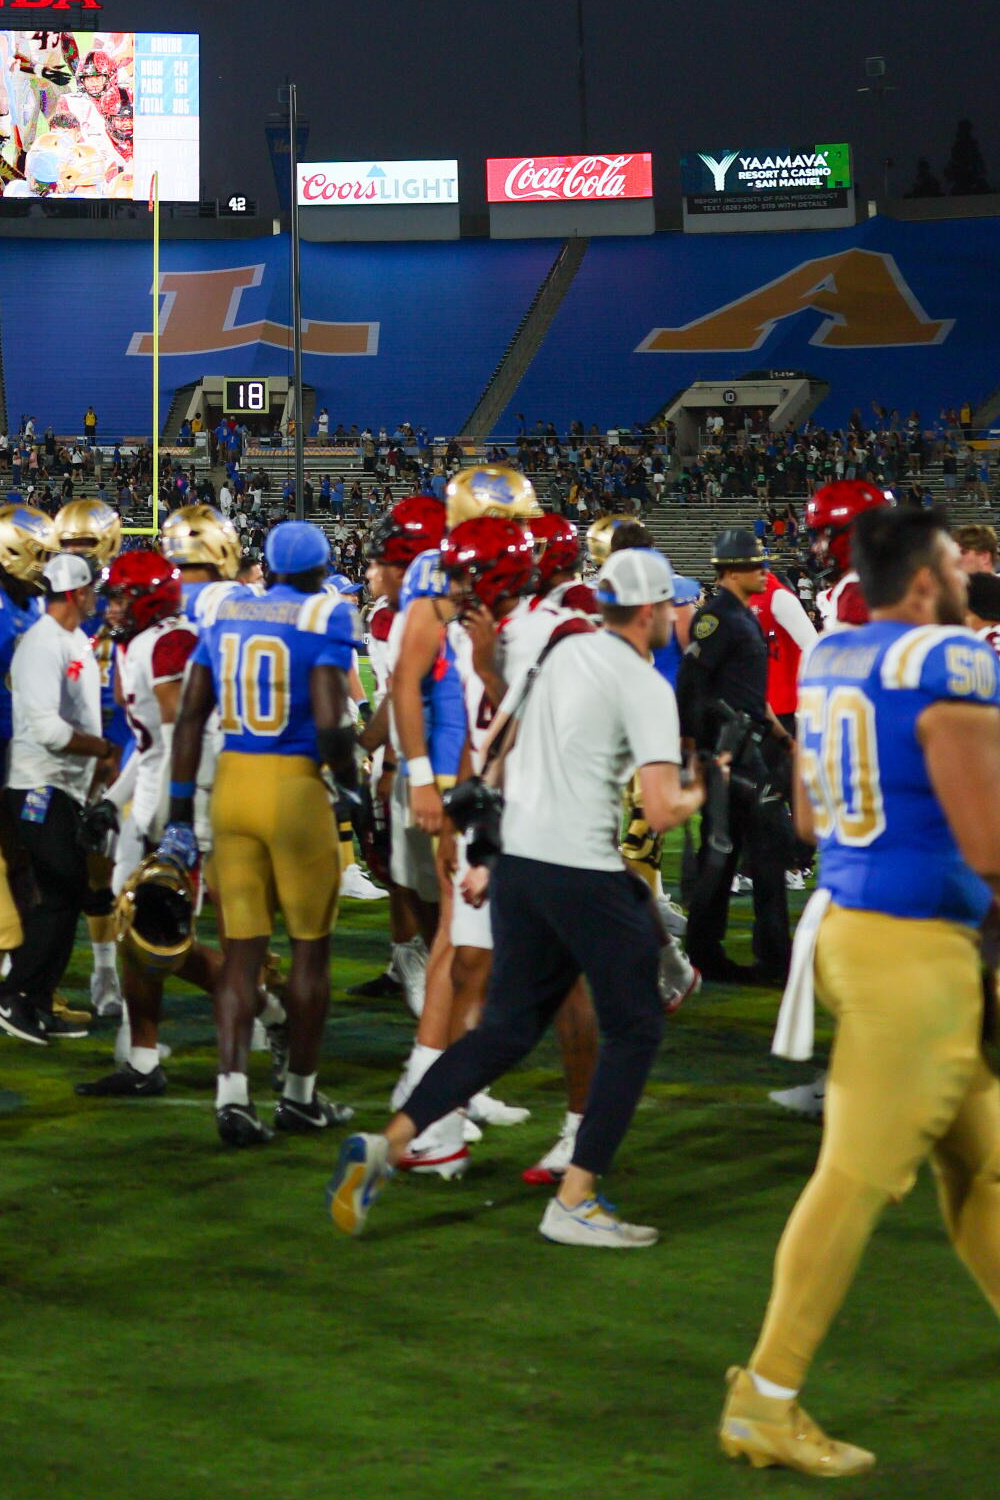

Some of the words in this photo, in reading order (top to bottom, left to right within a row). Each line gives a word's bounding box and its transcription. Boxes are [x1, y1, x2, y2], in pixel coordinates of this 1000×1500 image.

[140, 97, 164, 113] TOTAL
[504, 155, 633, 199] Coca-Cola
[738, 170, 779, 180] RESORT
[781, 169, 788, 178] &
[791, 167, 831, 177] CASINO
[755, 179, 778, 188] SAN
[779, 177, 823, 187] MANUEL
[302, 173, 379, 200] Coors
[379, 178, 456, 199] LIGHT
[228, 197, 246, 211] 42
[239, 382, 263, 409] 18
[725, 393, 735, 401] 10
[944, 643, 997, 700] 50
[219, 632, 291, 737] 10
